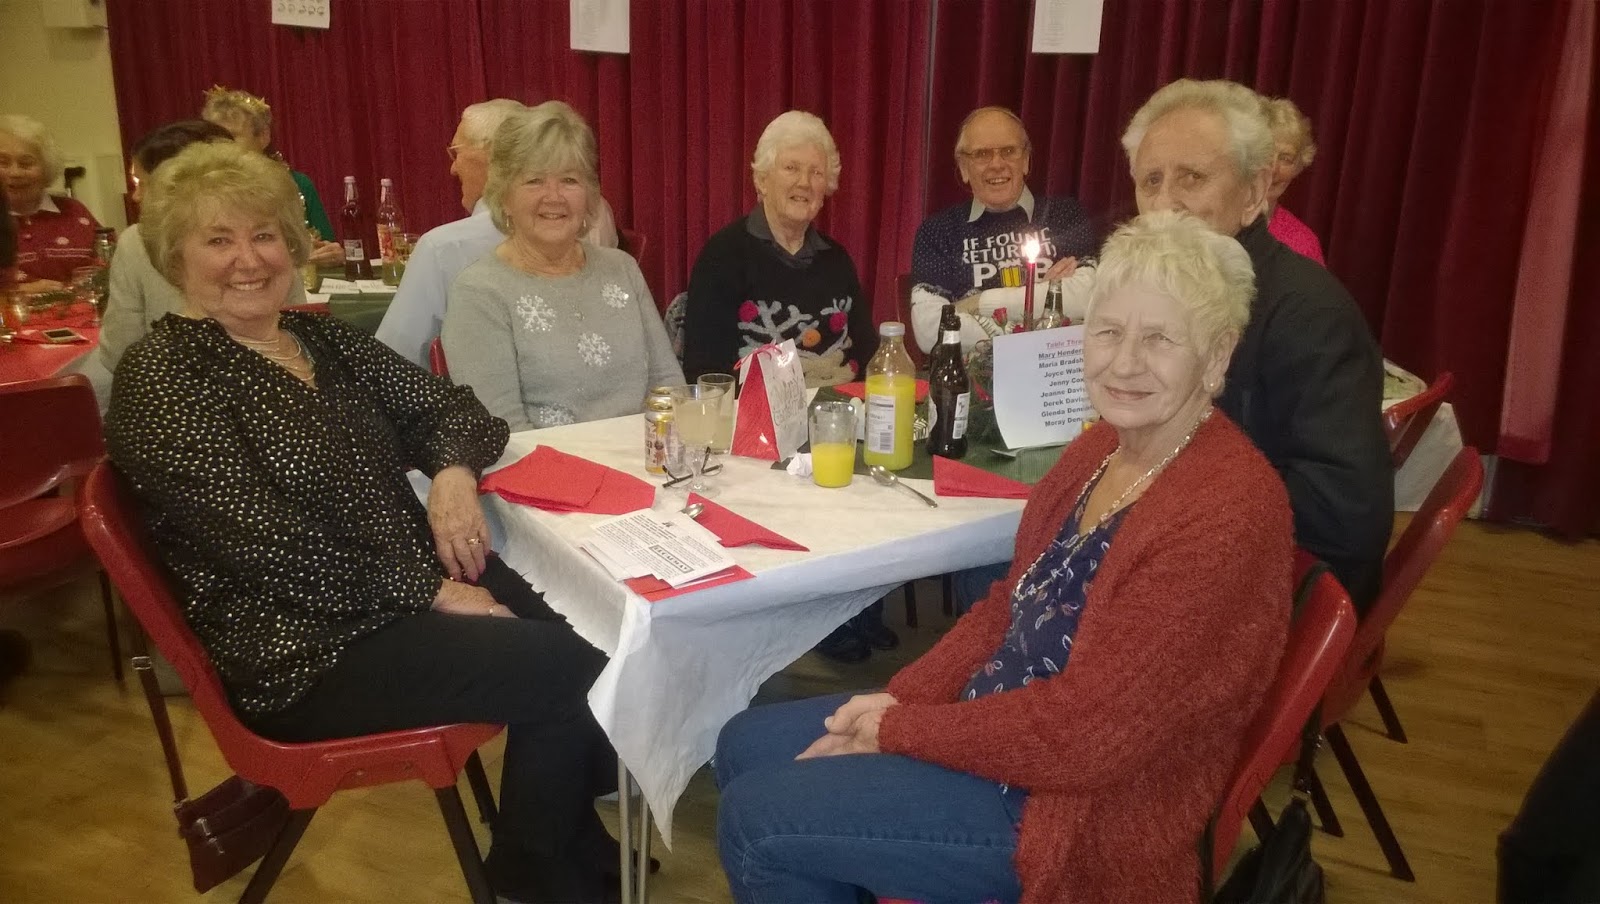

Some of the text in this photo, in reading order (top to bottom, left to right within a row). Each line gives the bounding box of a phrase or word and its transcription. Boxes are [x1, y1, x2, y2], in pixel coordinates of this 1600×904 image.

[962, 238, 979, 251] IF
[962, 243, 1039, 264] RETUR
[1060, 358, 1084, 366] Bradsh
[1049, 379, 1069, 387] Jenny
[1041, 390, 1065, 398] Jeanne
[1043, 399, 1064, 407] Derek
[1045, 419, 1065, 427] Moray
